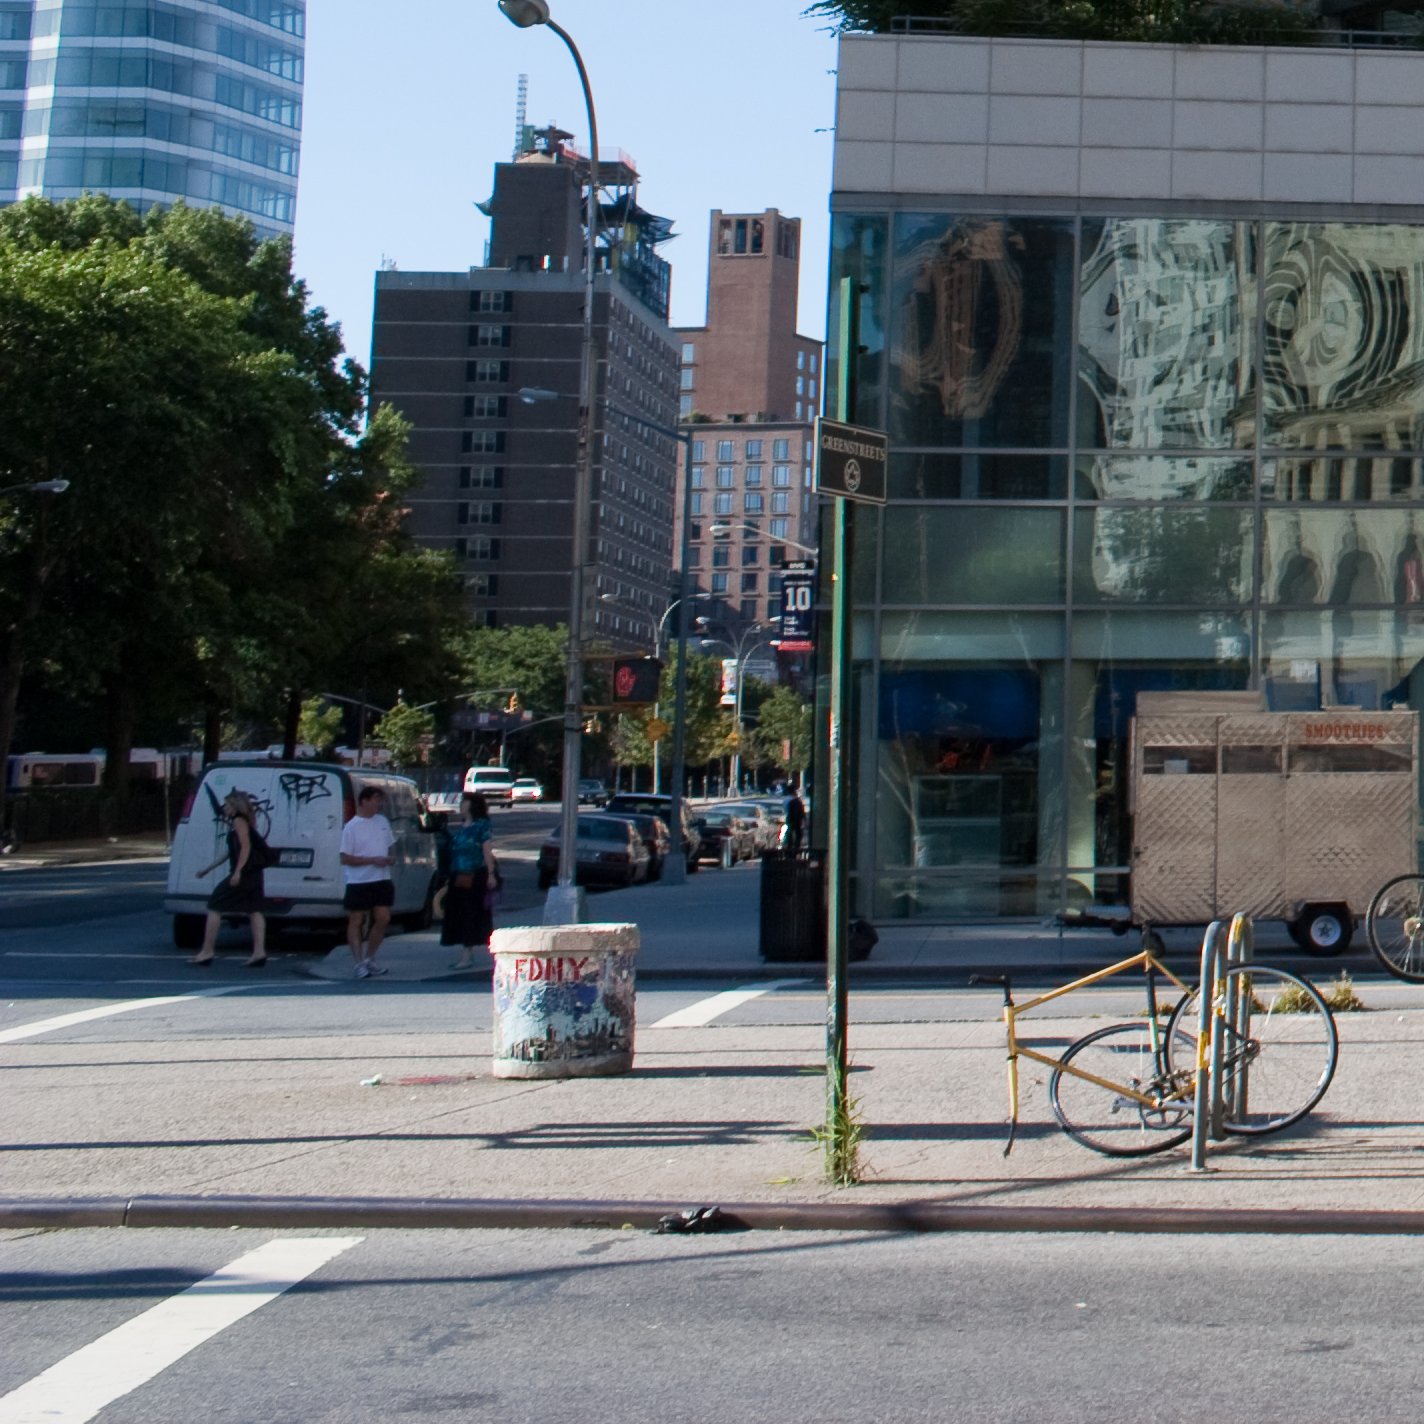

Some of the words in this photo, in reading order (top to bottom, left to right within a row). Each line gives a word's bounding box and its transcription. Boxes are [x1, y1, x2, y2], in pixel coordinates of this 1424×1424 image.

[821, 434, 887, 462] GREENSTREETS
[785, 586, 811, 611] 10
[1305, 723, 1384, 739] SMOOTHIES
